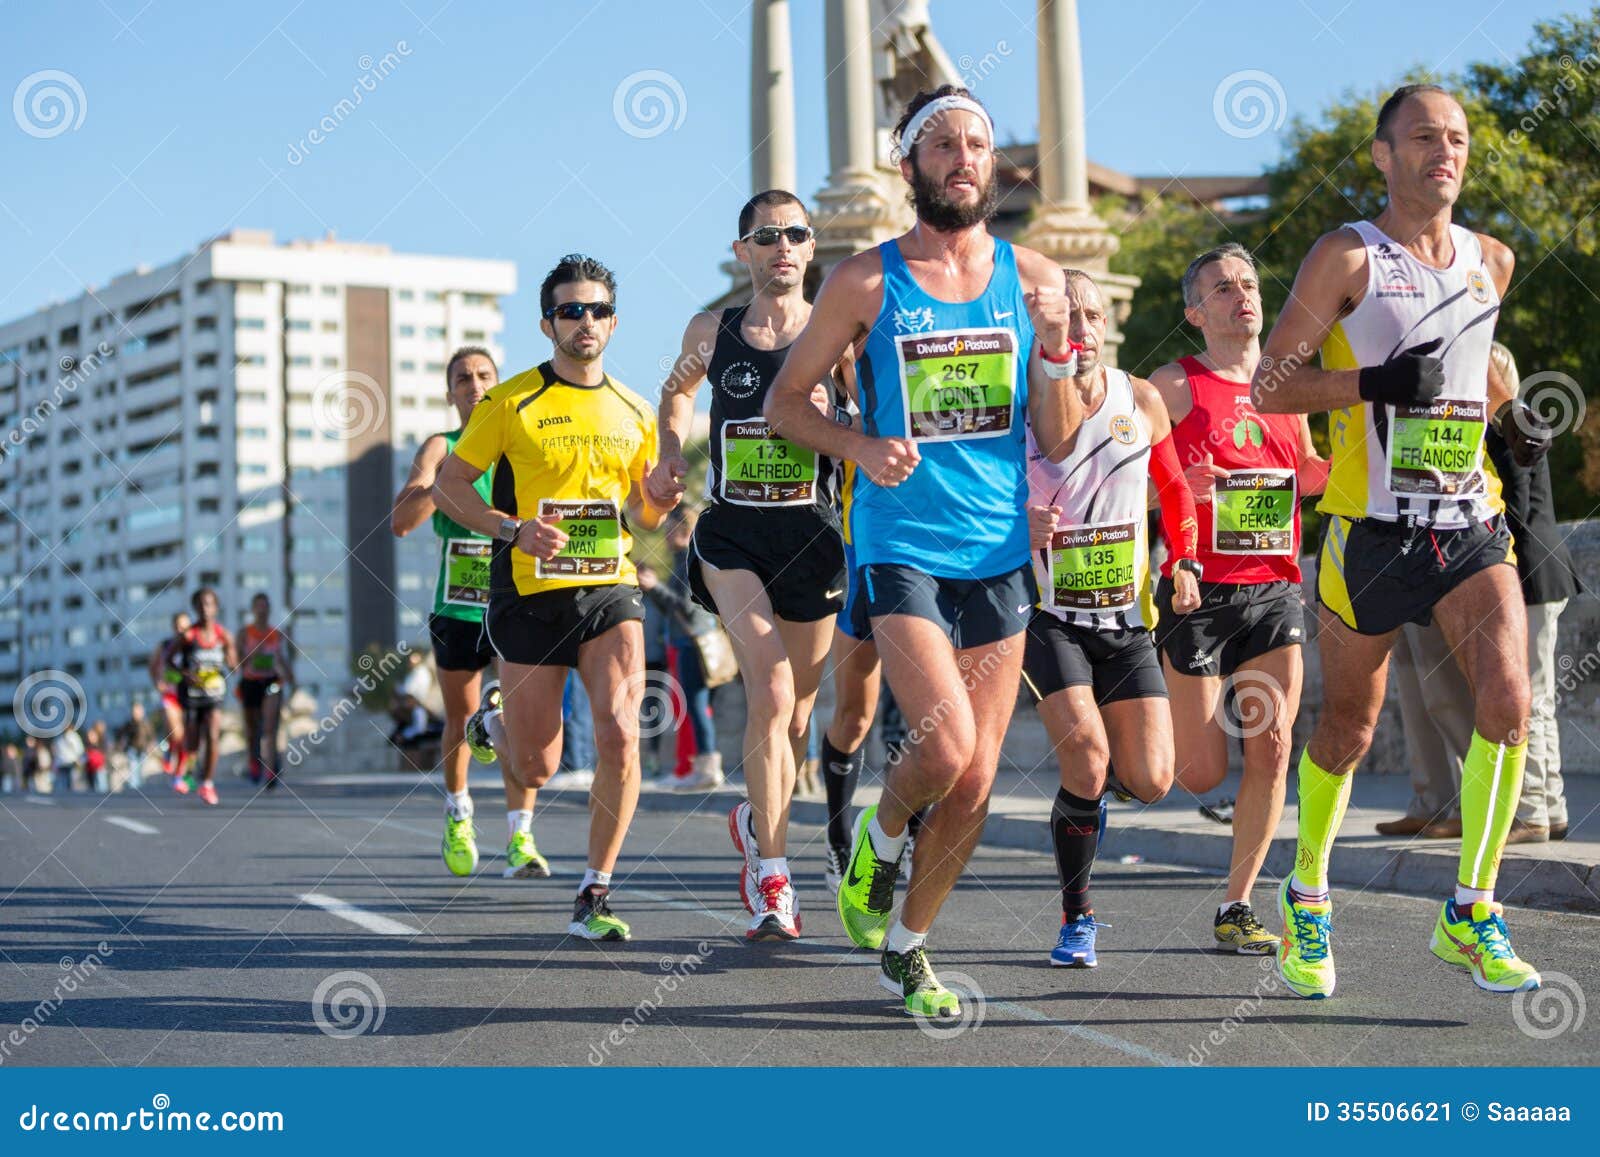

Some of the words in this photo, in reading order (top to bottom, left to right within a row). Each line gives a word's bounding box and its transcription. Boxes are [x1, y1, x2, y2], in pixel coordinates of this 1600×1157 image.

[916, 343, 948, 355] Divina
[964, 339, 1000, 351] Pastora
[942, 362, 980, 382] 267
[934, 384, 989, 407] TONIET
[1453, 404, 1481, 417] Pastora
[736, 425, 762, 436] Divina
[1430, 426, 1463, 444] 144
[541, 434, 590, 450] PATERNA
[755, 444, 787, 460] 173
[740, 462, 803, 479] ALFREDO
[1226, 478, 1251, 488] Divina
[1245, 495, 1274, 510] 270
[553, 508, 576, 517] Divina
[1239, 512, 1279, 529] PEKAS
[568, 523, 598, 538] 296
[1062, 534, 1088, 545] Divina
[1102, 530, 1129, 541] Pastora
[567, 539, 596, 555] IVAN
[1083, 549, 1115, 567] 135
[1056, 570, 1103, 588] JORGE
[1106, 564, 1133, 584] CRUZ
